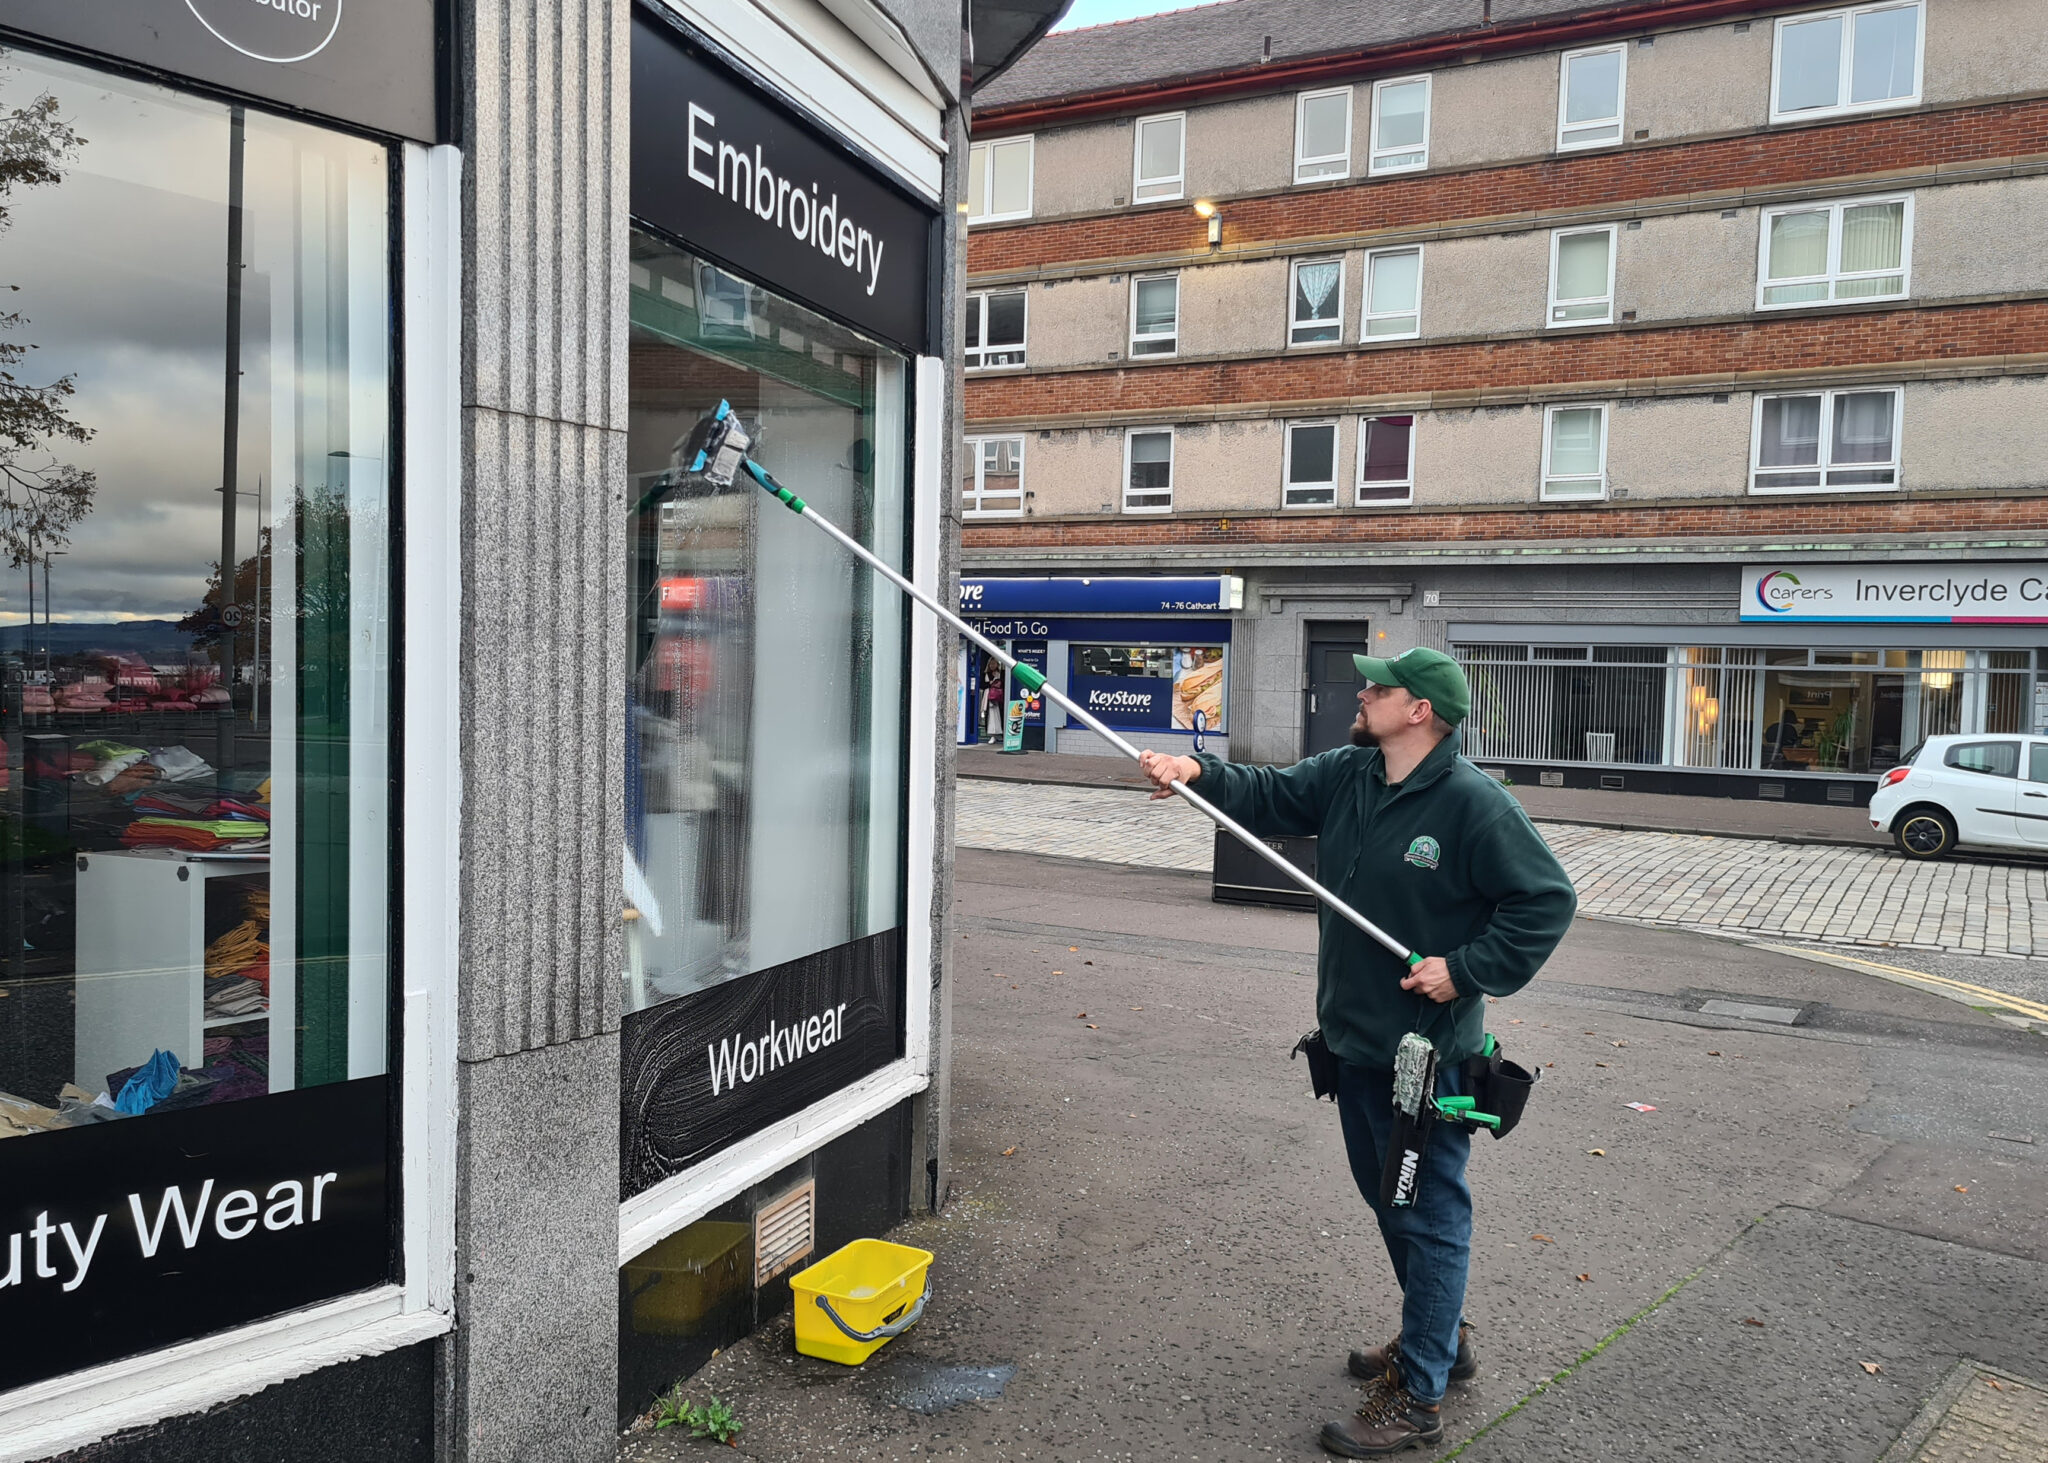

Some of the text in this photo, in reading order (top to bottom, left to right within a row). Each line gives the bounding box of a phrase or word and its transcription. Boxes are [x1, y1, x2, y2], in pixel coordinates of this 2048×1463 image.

[256, 0, 322, 21] utor
[688, 101, 884, 296] Embroidery
[1425, 594, 1438, 603] 70
[1855, 578, 2048, 607] Inverclyde C
[1185, 601, 1217, 610] Cathcart
[983, 621, 1012, 634] Food
[1014, 621, 1028, 634] To
[1031, 621, 1049, 635] Go
[1089, 690, 1152, 706] KeyStore
[708, 1003, 846, 1096] Workwear
[1395, 1149, 1419, 1199] NINJA
[128, 1172, 338, 1258] Wear
